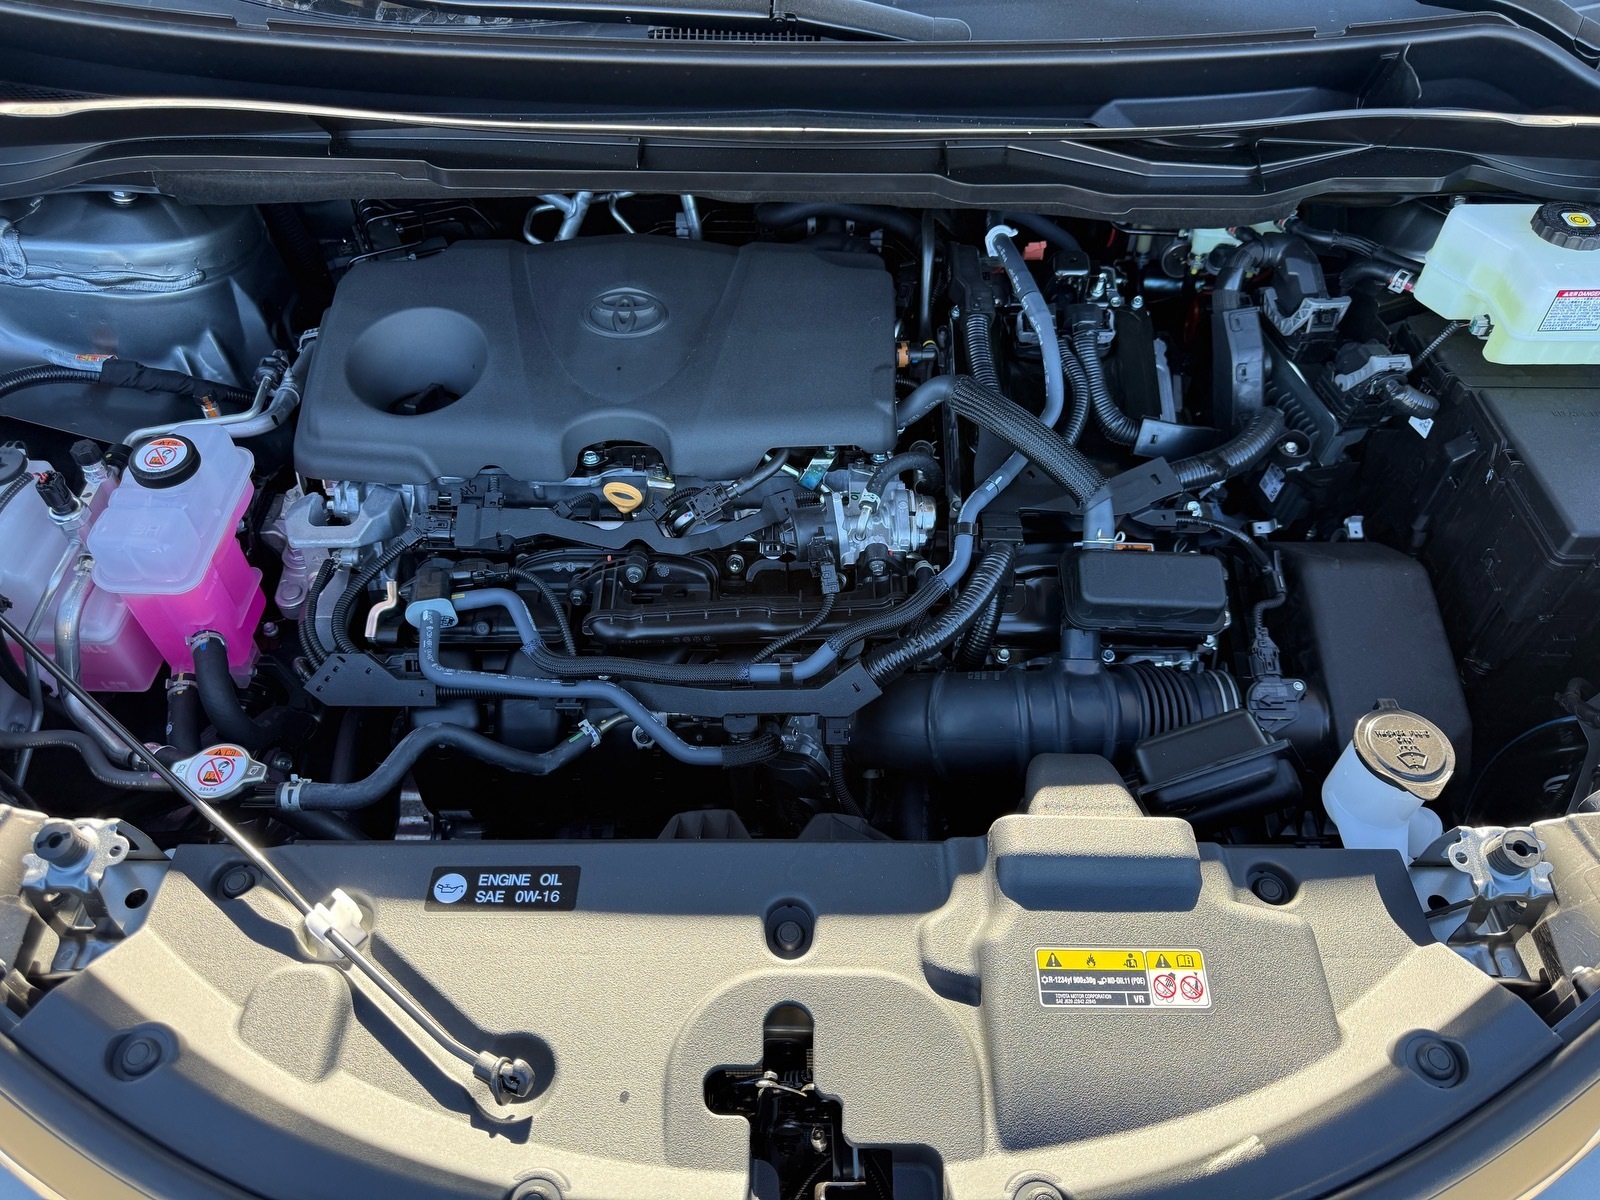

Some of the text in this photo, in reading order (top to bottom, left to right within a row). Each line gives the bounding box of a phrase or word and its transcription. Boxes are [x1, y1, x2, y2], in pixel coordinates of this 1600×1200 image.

[478, 873, 563, 886] ENGINE OIL
[474, 890, 560, 903] SAE 0W-16
[1133, 994, 1145, 1004] VR
